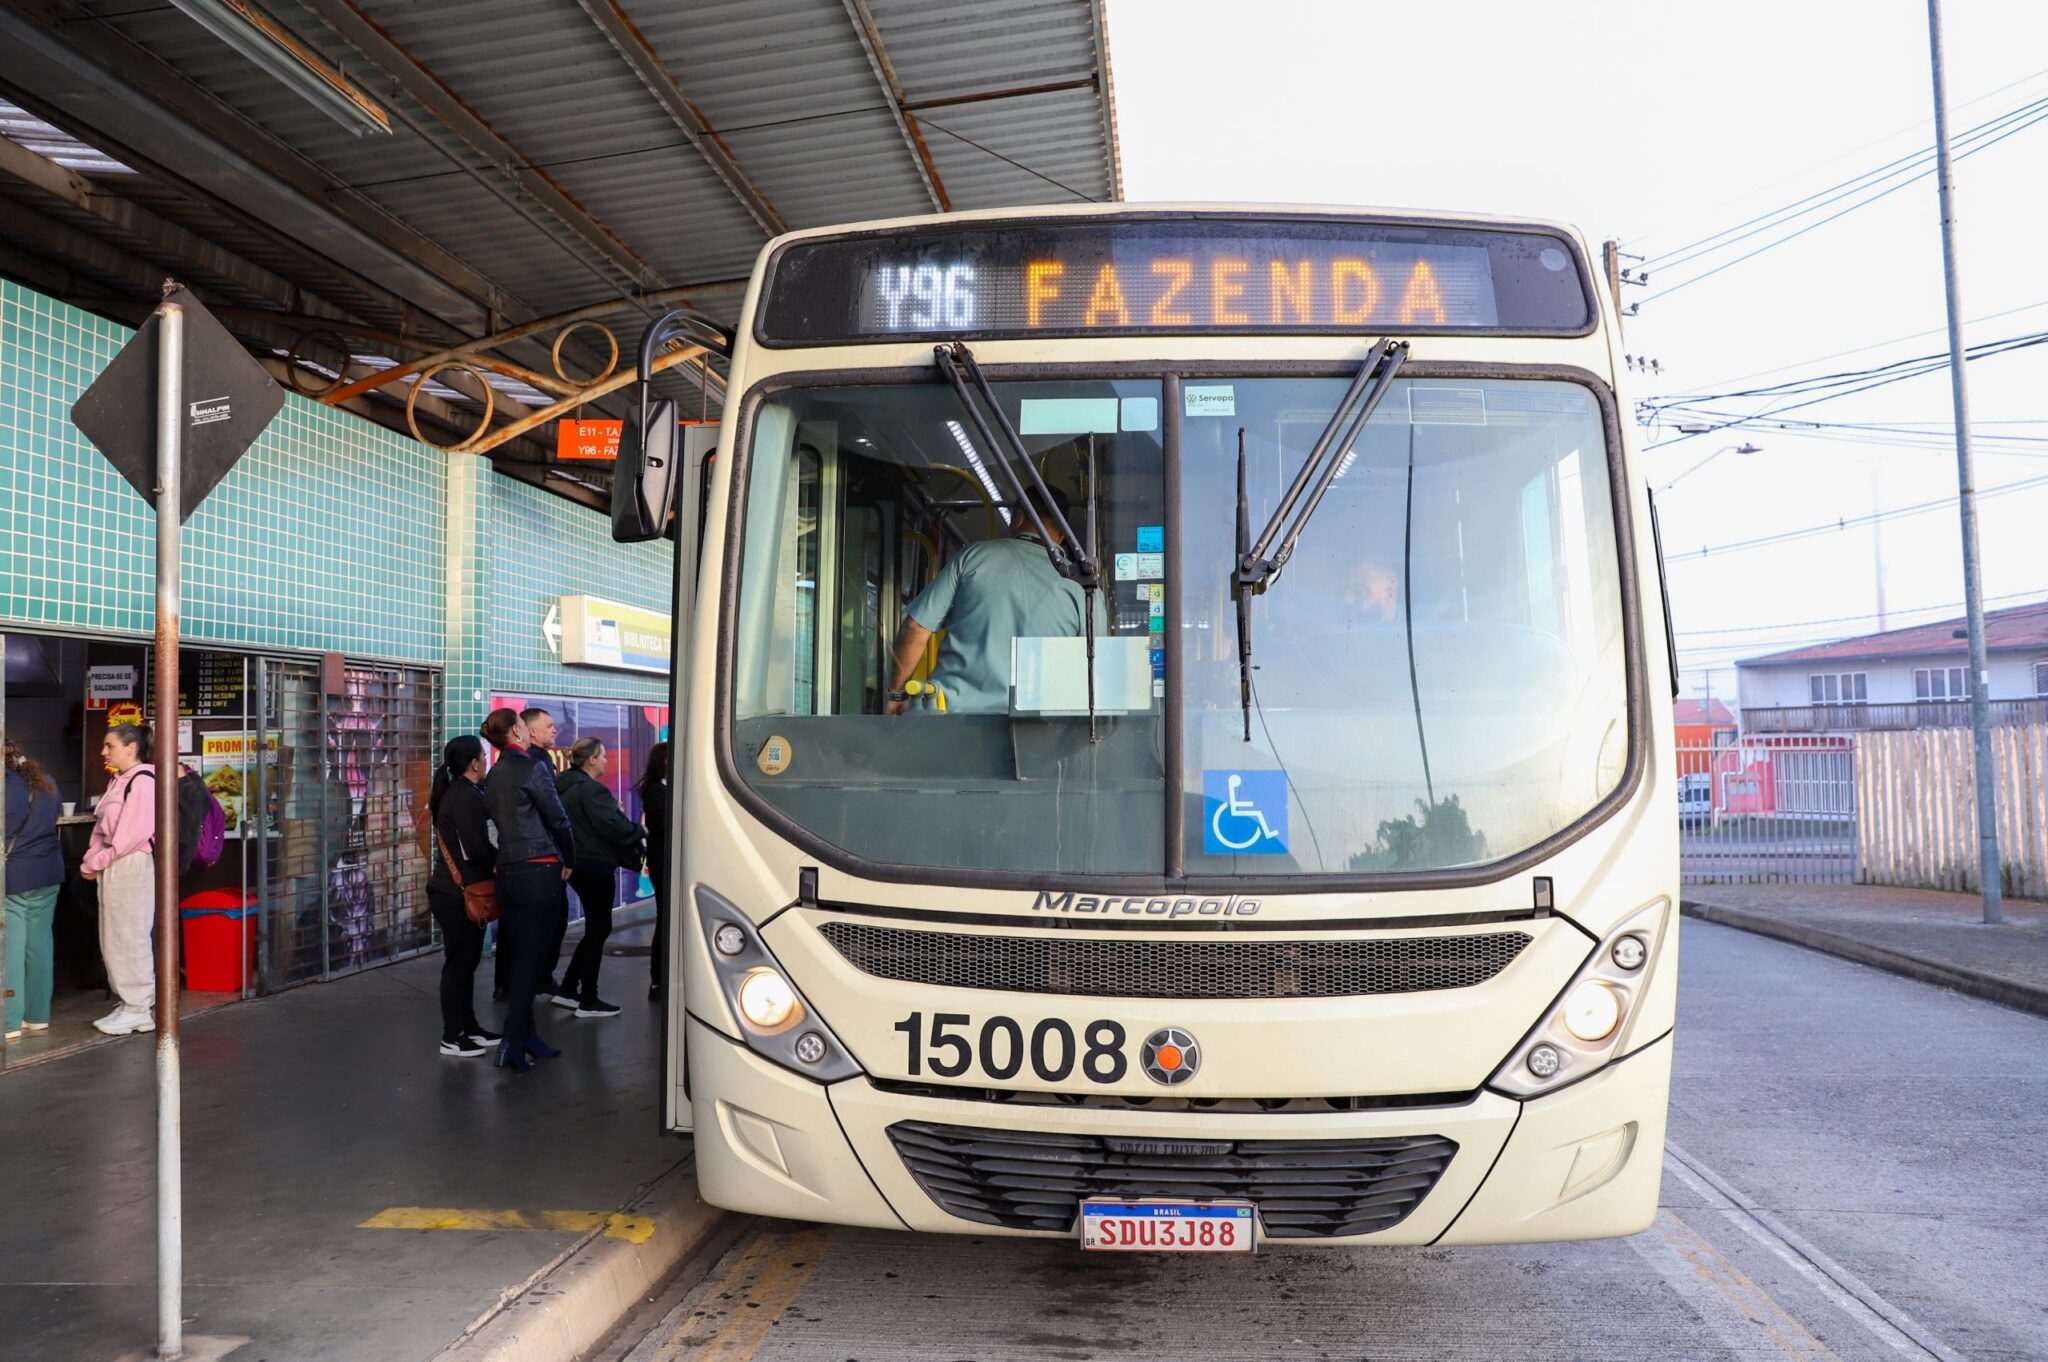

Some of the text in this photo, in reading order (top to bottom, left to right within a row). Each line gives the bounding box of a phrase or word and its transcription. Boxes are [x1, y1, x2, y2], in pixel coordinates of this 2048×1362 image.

[880, 260, 1445, 328] Y96 FAZENDA
[579, 426, 597, 437] E11
[577, 445, 597, 455] Y96
[91, 672, 132, 680] PRECISA-SE DE
[207, 738, 275, 753] PROMÇO
[1032, 889, 1261, 918] Marcopolo
[894, 1011, 1128, 1084] 15008
[1153, 1208, 1182, 1217] BRASIL
[1100, 1218, 1235, 1247] SDU3J88
[1085, 1237, 1096, 1246] BR
